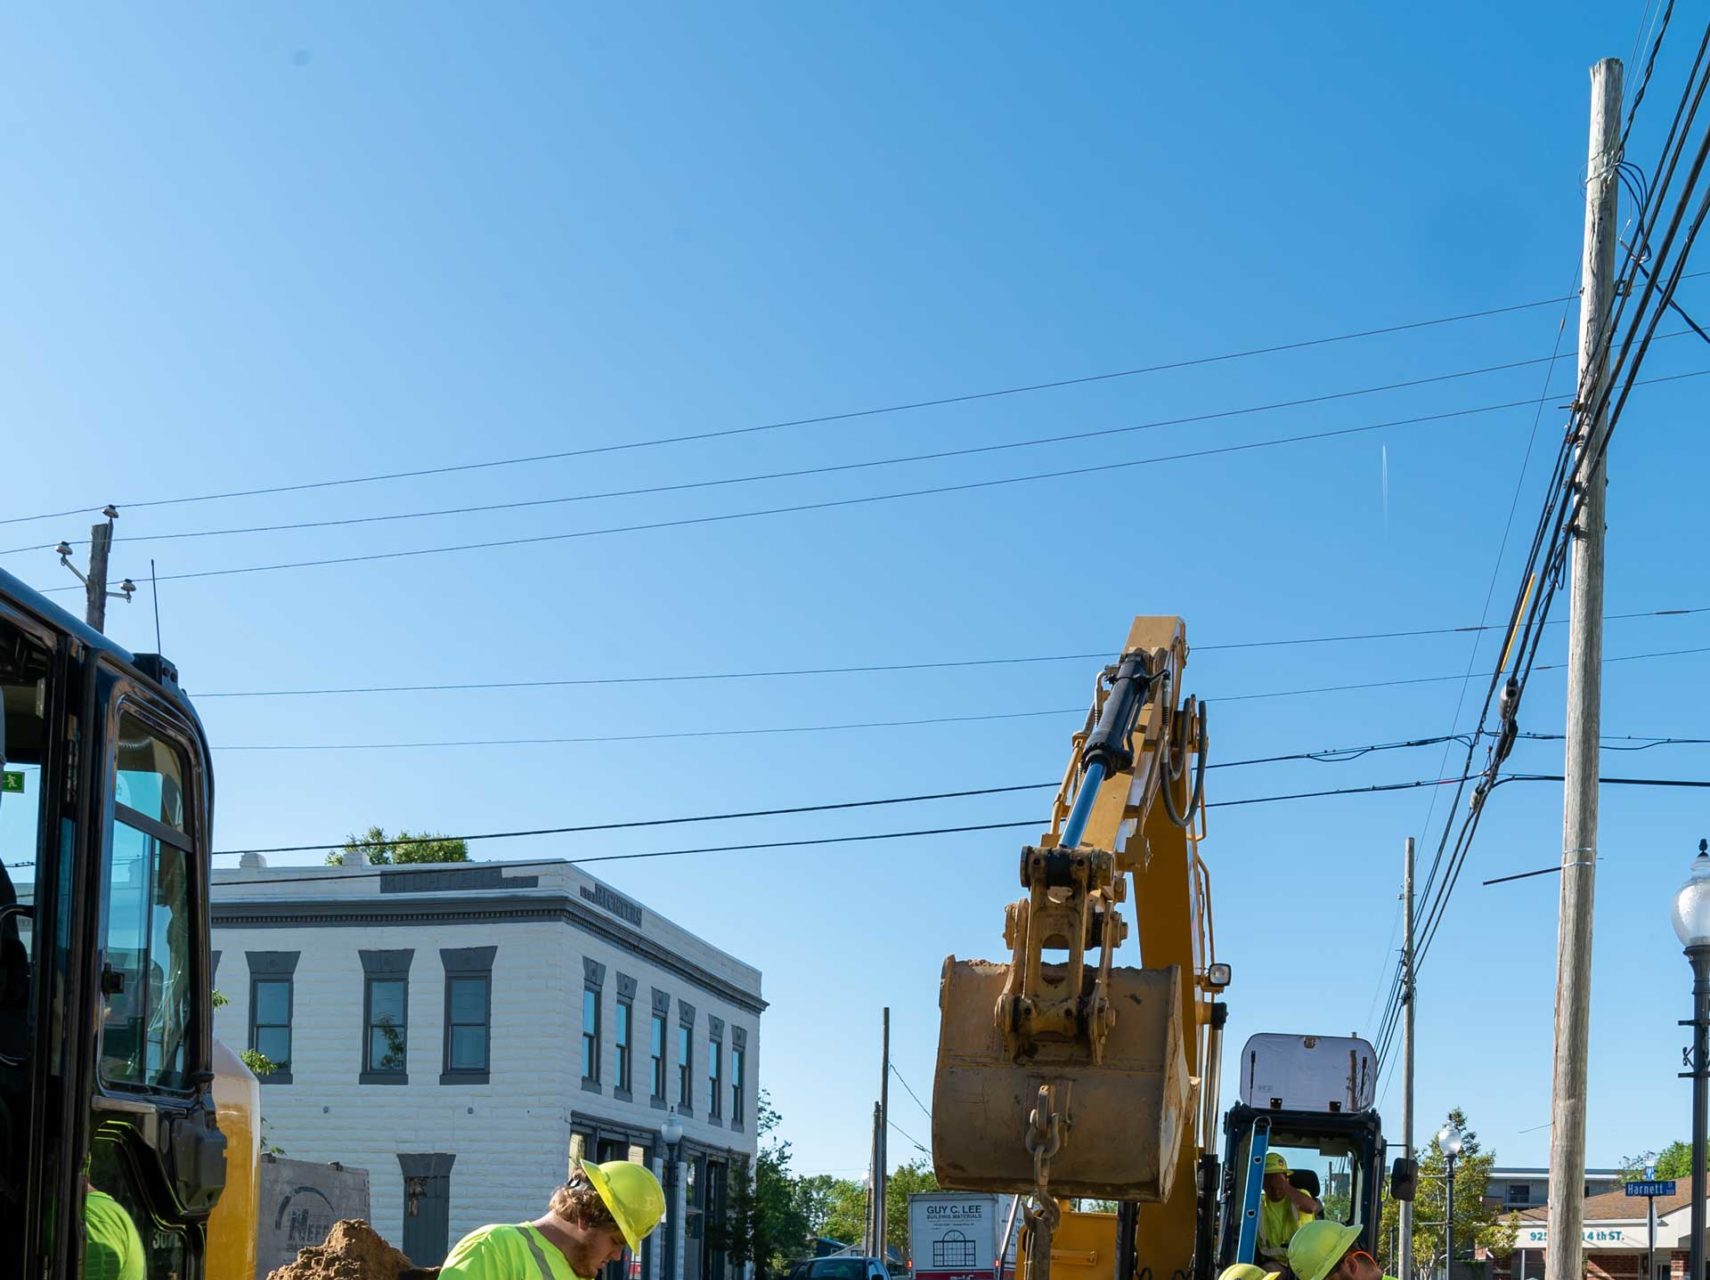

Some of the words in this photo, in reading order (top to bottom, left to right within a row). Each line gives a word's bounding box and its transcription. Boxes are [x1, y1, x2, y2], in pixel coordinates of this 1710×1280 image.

[1627, 1183, 1663, 1195] Harnett
[926, 1205, 948, 1214] GUY
[950, 1205, 960, 1214] C.
[962, 1204, 982, 1214] LEE
[1609, 1231, 1625, 1241] ST.
